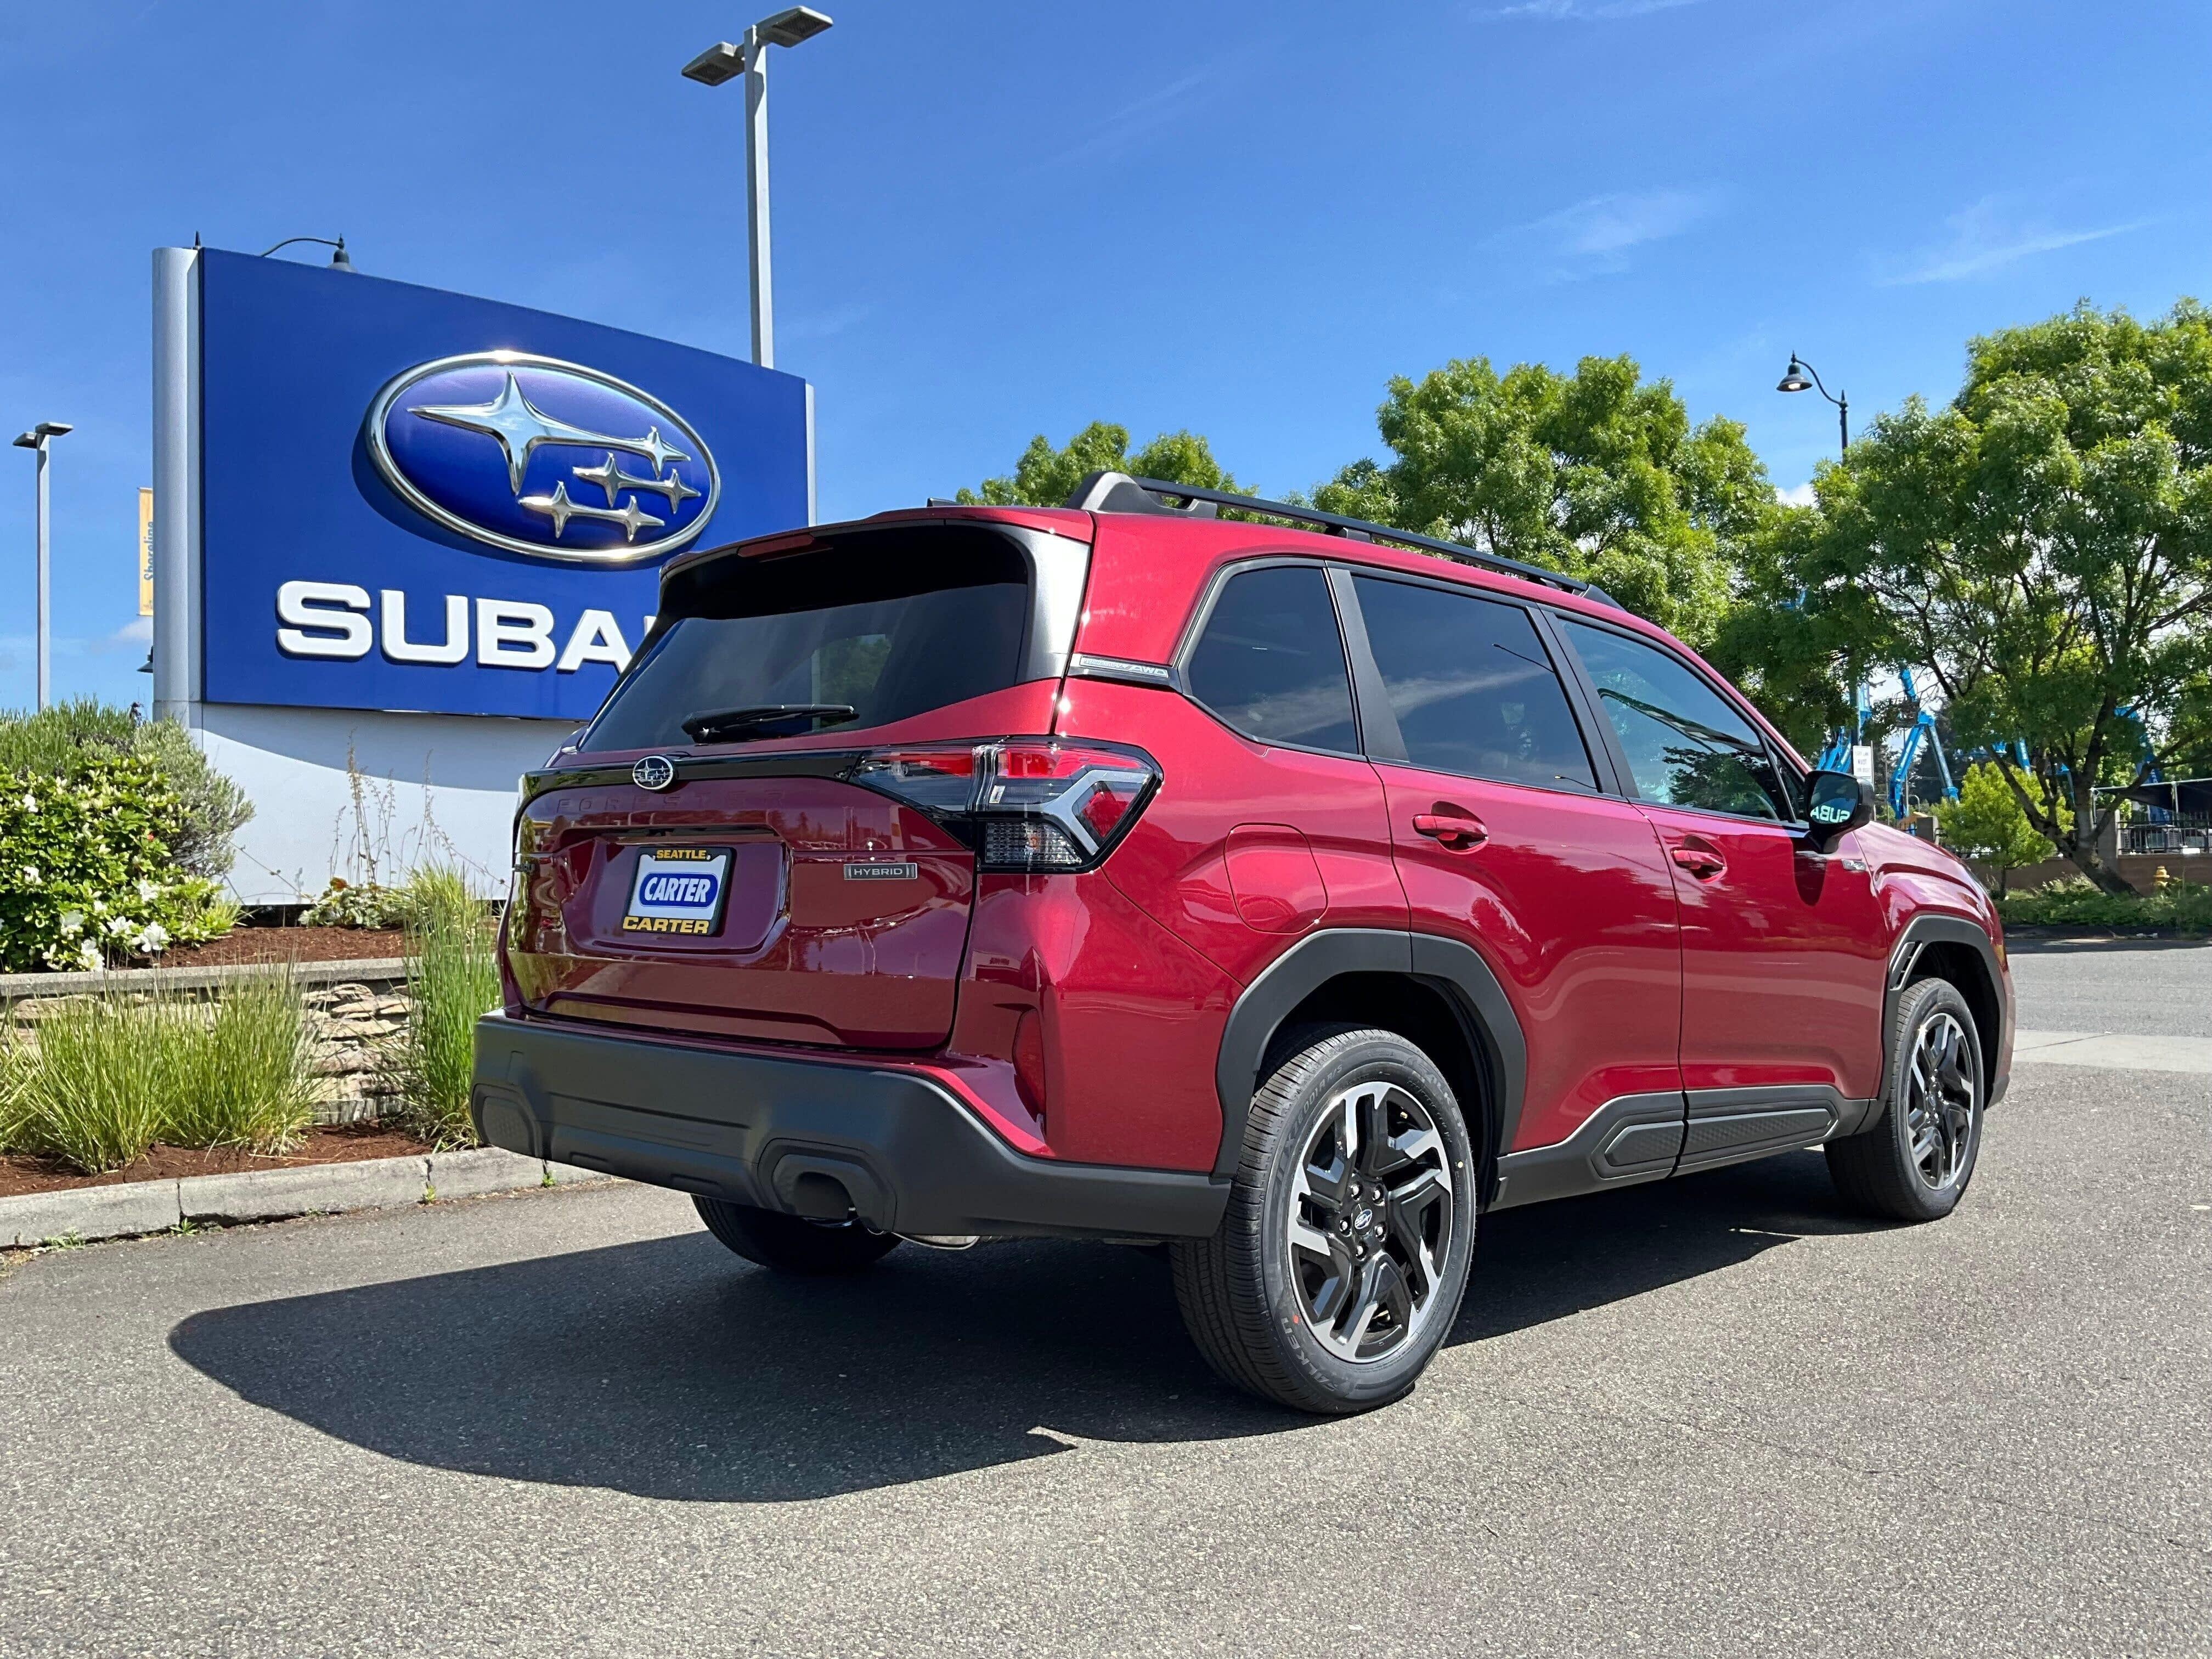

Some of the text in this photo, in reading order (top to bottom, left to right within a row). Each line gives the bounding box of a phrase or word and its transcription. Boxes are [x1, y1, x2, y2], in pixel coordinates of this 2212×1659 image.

[277, 580, 657, 672] SUBA
[1128, 665, 1166, 676] AWD
[656, 849, 707, 860] SEATTLE
[644, 877, 711, 902] CARTER
[622, 916, 709, 934] CARTER
